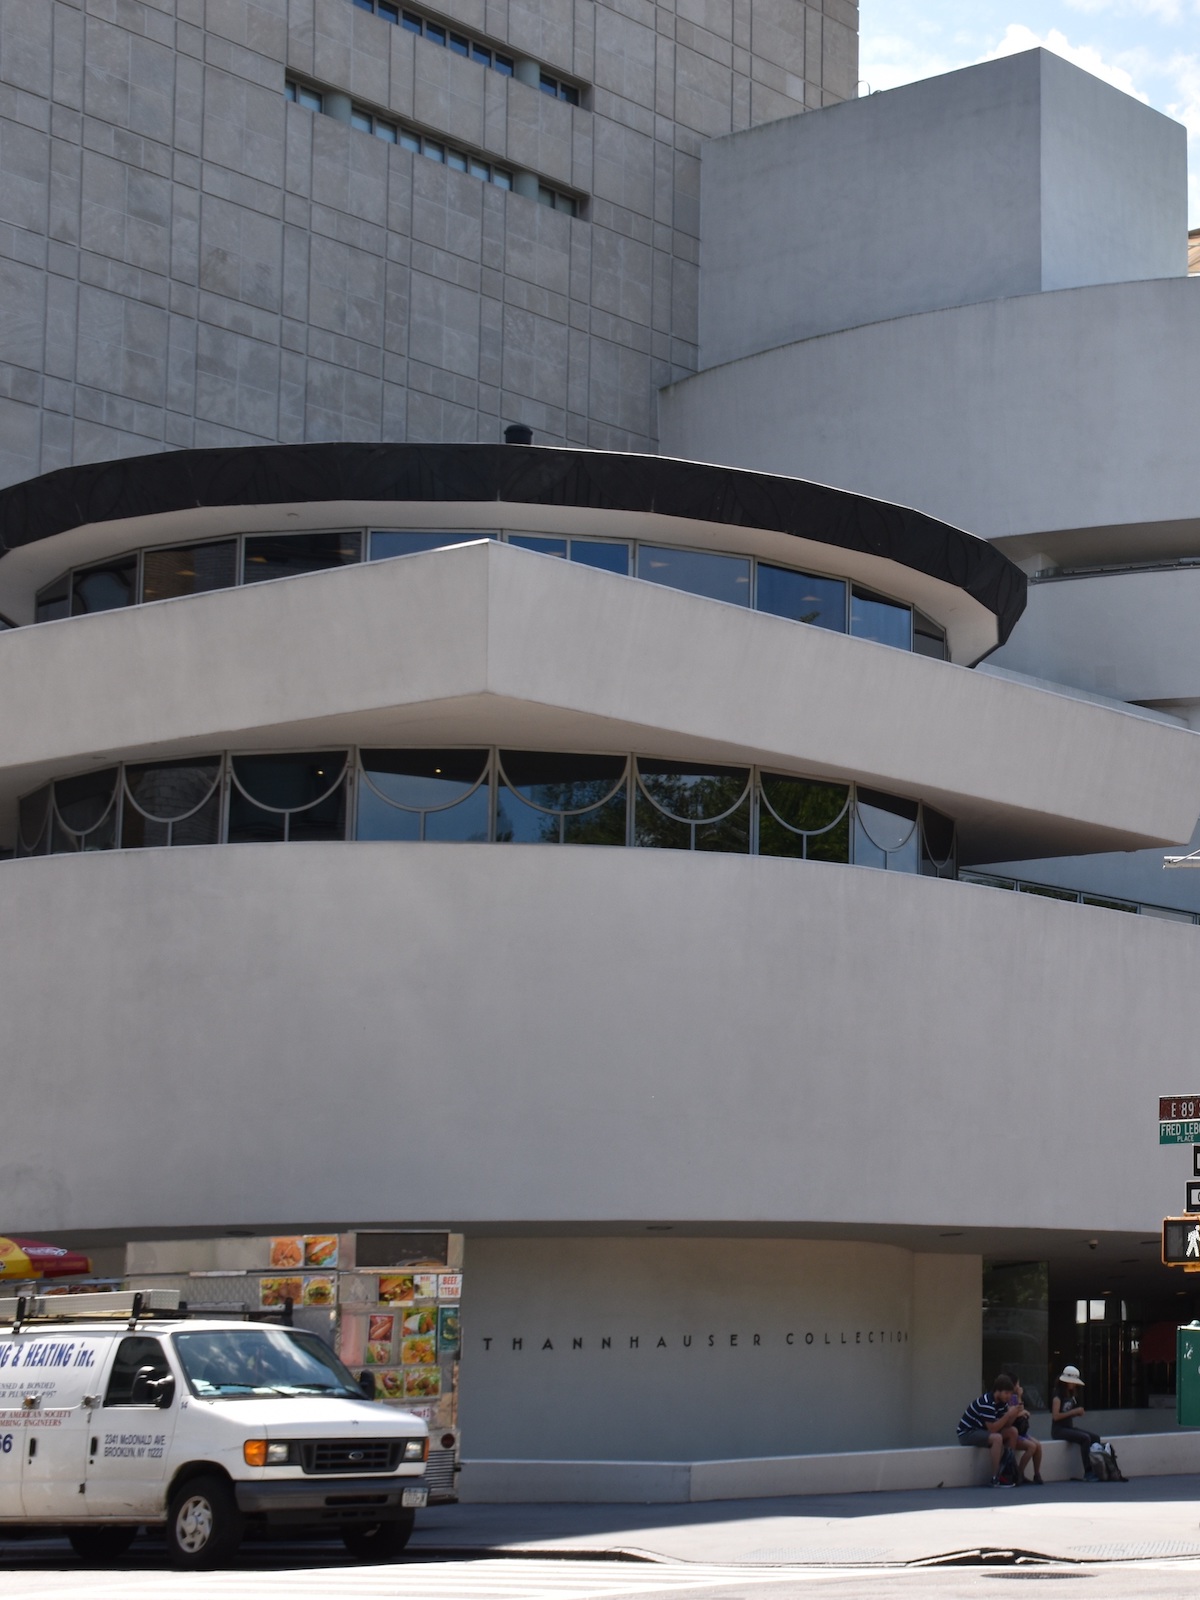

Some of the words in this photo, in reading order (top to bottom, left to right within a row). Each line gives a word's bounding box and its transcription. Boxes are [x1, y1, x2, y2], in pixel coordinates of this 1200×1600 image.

[1171, 1102, 1177, 1118] E
[1181, 1101, 1195, 1117] 89
[1161, 1123, 1182, 1137] FRED
[442, 1275, 458, 1285] BEEF
[483, 1334, 761, 1351] THANNHAUSER
[23, 1343, 76, 1368] HEATING
[73, 1341, 95, 1368] inc.
[44, 1410, 72, 1418] SOCIETY
[24, 1419, 62, 1427] ENGINEERS
[0, 1433, 13, 1453] 6
